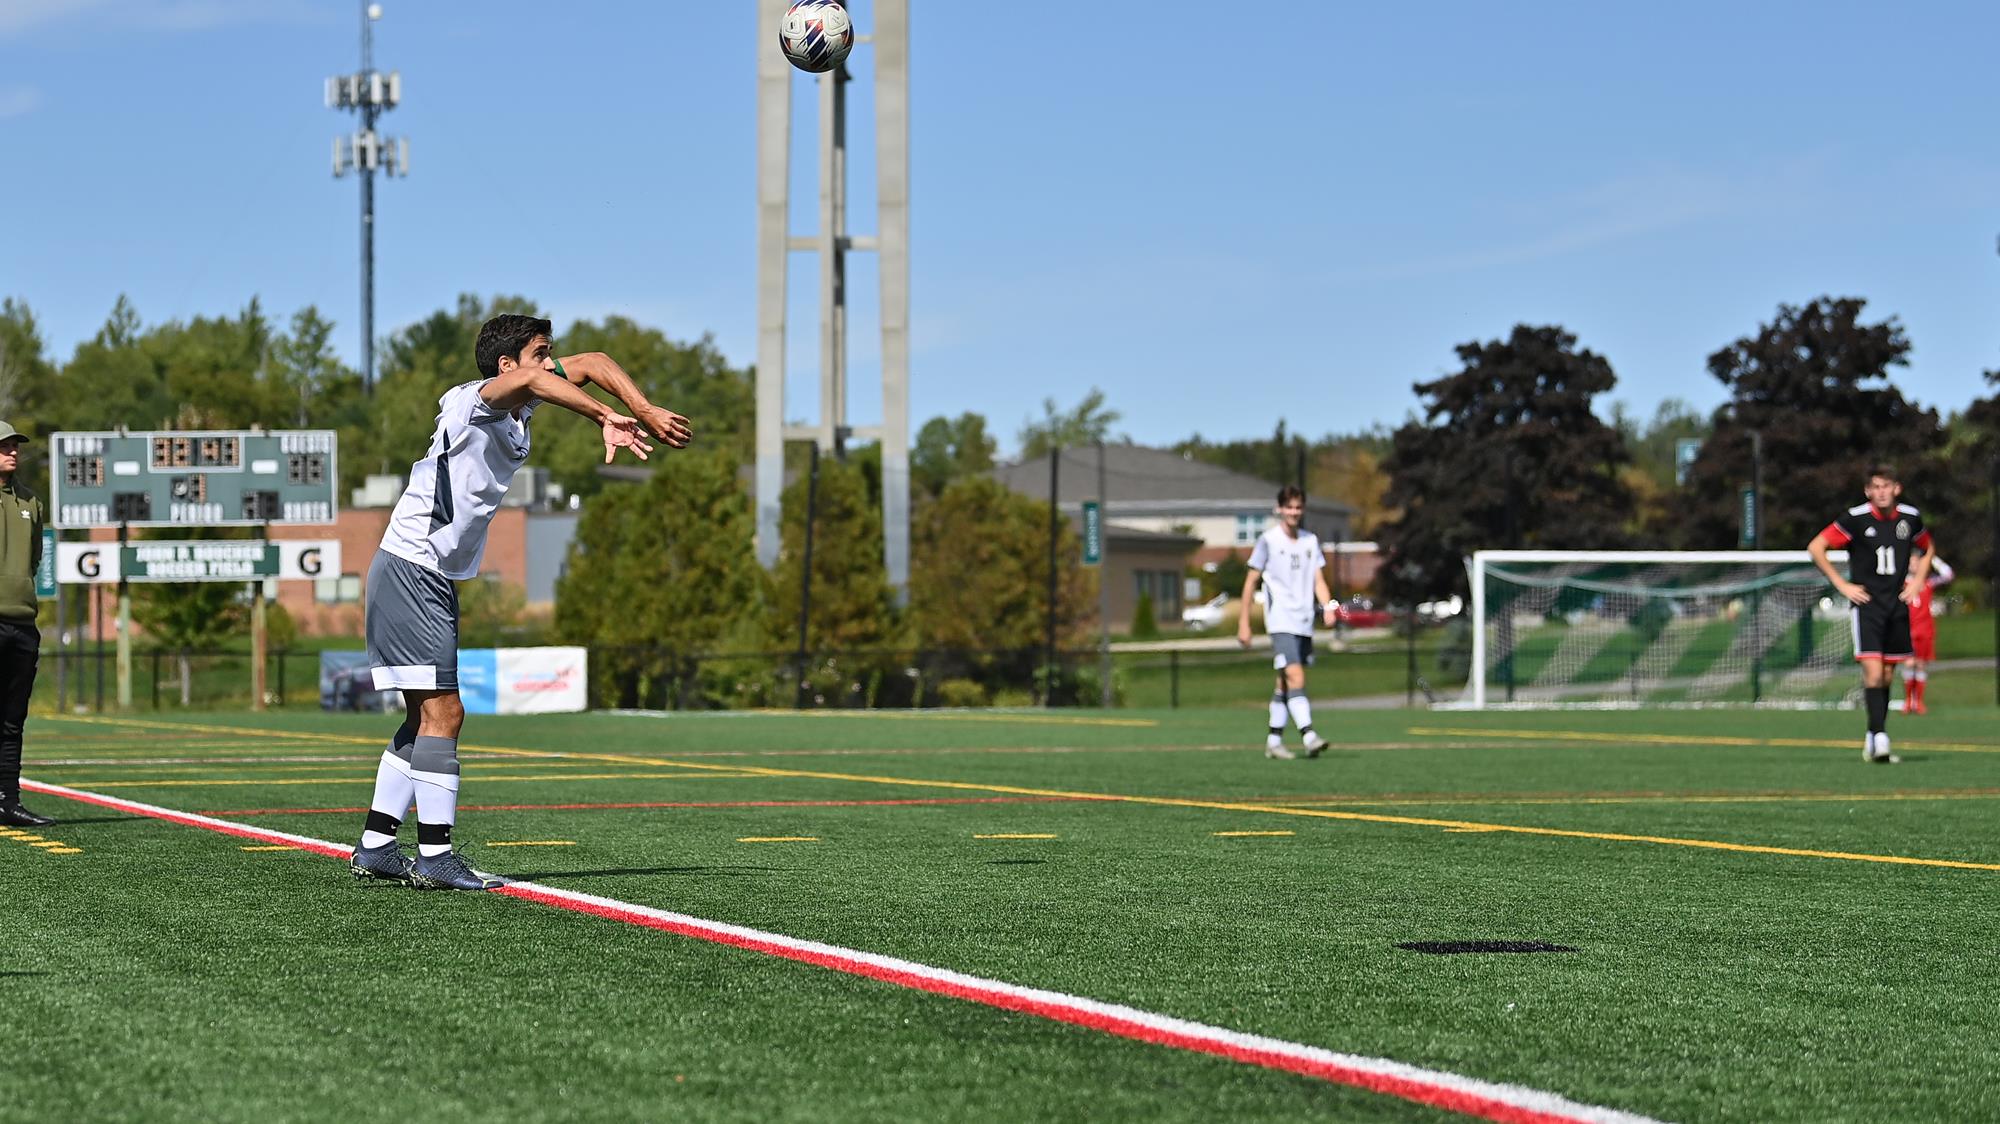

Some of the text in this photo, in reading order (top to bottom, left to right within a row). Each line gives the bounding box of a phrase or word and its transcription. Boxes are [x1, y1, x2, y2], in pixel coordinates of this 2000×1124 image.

[77, 550, 100, 577] G
[298, 548, 321, 576] G
[1875, 545, 1896, 575] 11
